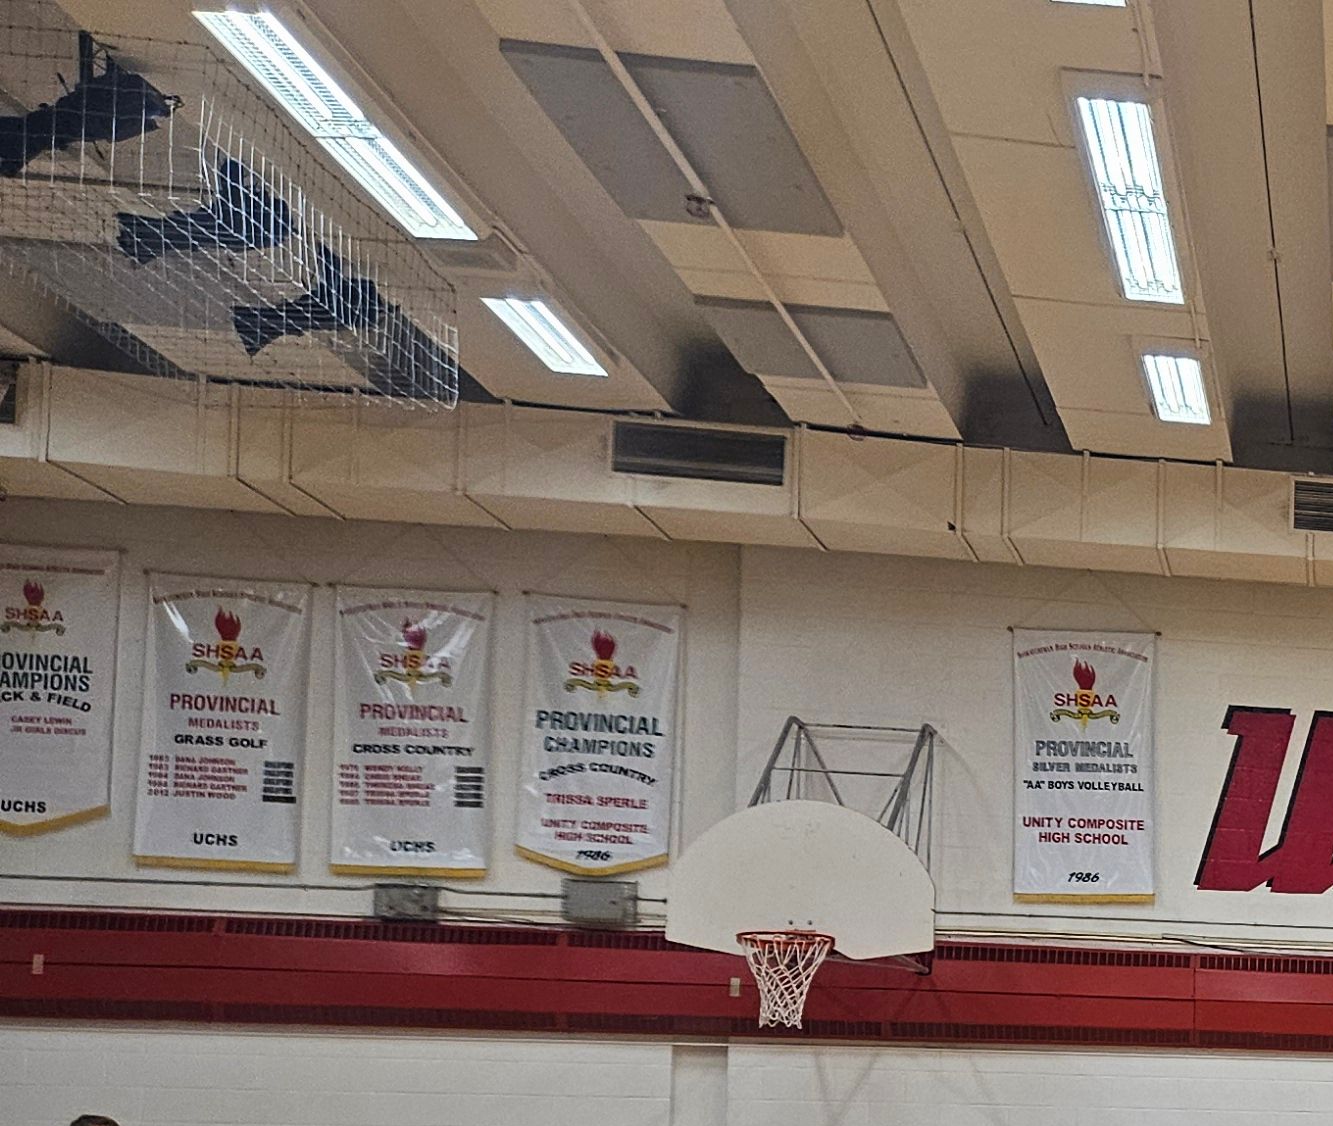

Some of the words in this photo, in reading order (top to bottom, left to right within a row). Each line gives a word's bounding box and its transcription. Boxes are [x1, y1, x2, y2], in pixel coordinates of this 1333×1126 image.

[5, 606, 64, 622] SHSAA
[192, 643, 264, 661] SHSAA
[0, 652, 93, 674] OVINCIAL
[569, 661, 639, 680] SHSAA
[0, 671, 91, 692] AMPIONS
[47, 692, 92, 713] FIELD
[170, 693, 280, 716] PROVINCIAL
[1054, 693, 1118, 707] SHSAA
[360, 702, 469, 723] PROVINCIAL
[188, 717, 260, 731] MEDALISTS
[535, 709, 665, 737] PROVINCIAL
[174, 734, 225, 746] GRASS
[229, 737, 268, 749] GOLF
[544, 735, 656, 759] CHAMPIONS
[1035, 740, 1134, 758] PROVINCIAL
[353, 743, 401, 754] CROSS
[404, 743, 474, 757] COUNTRY
[538, 762, 587, 782] CROSS
[589, 762, 659, 787] COUNTRY
[1032, 762, 1071, 772] SILVER
[1075, 762, 1138, 774] MEDALISTS
[1048, 780, 1074, 790] BOYS
[1077, 781, 1144, 792] VOLLEYBALL
[1, 800, 47, 813] UCHS
[1022, 816, 1063, 828] UNITY
[1067, 818, 1145, 831] COMPOSITE
[193, 832, 239, 847] UCHS
[1039, 831, 1070, 843] HIGH
[1074, 833, 1129, 845] SCHOOL
[1067, 871, 1100, 883] 1986
